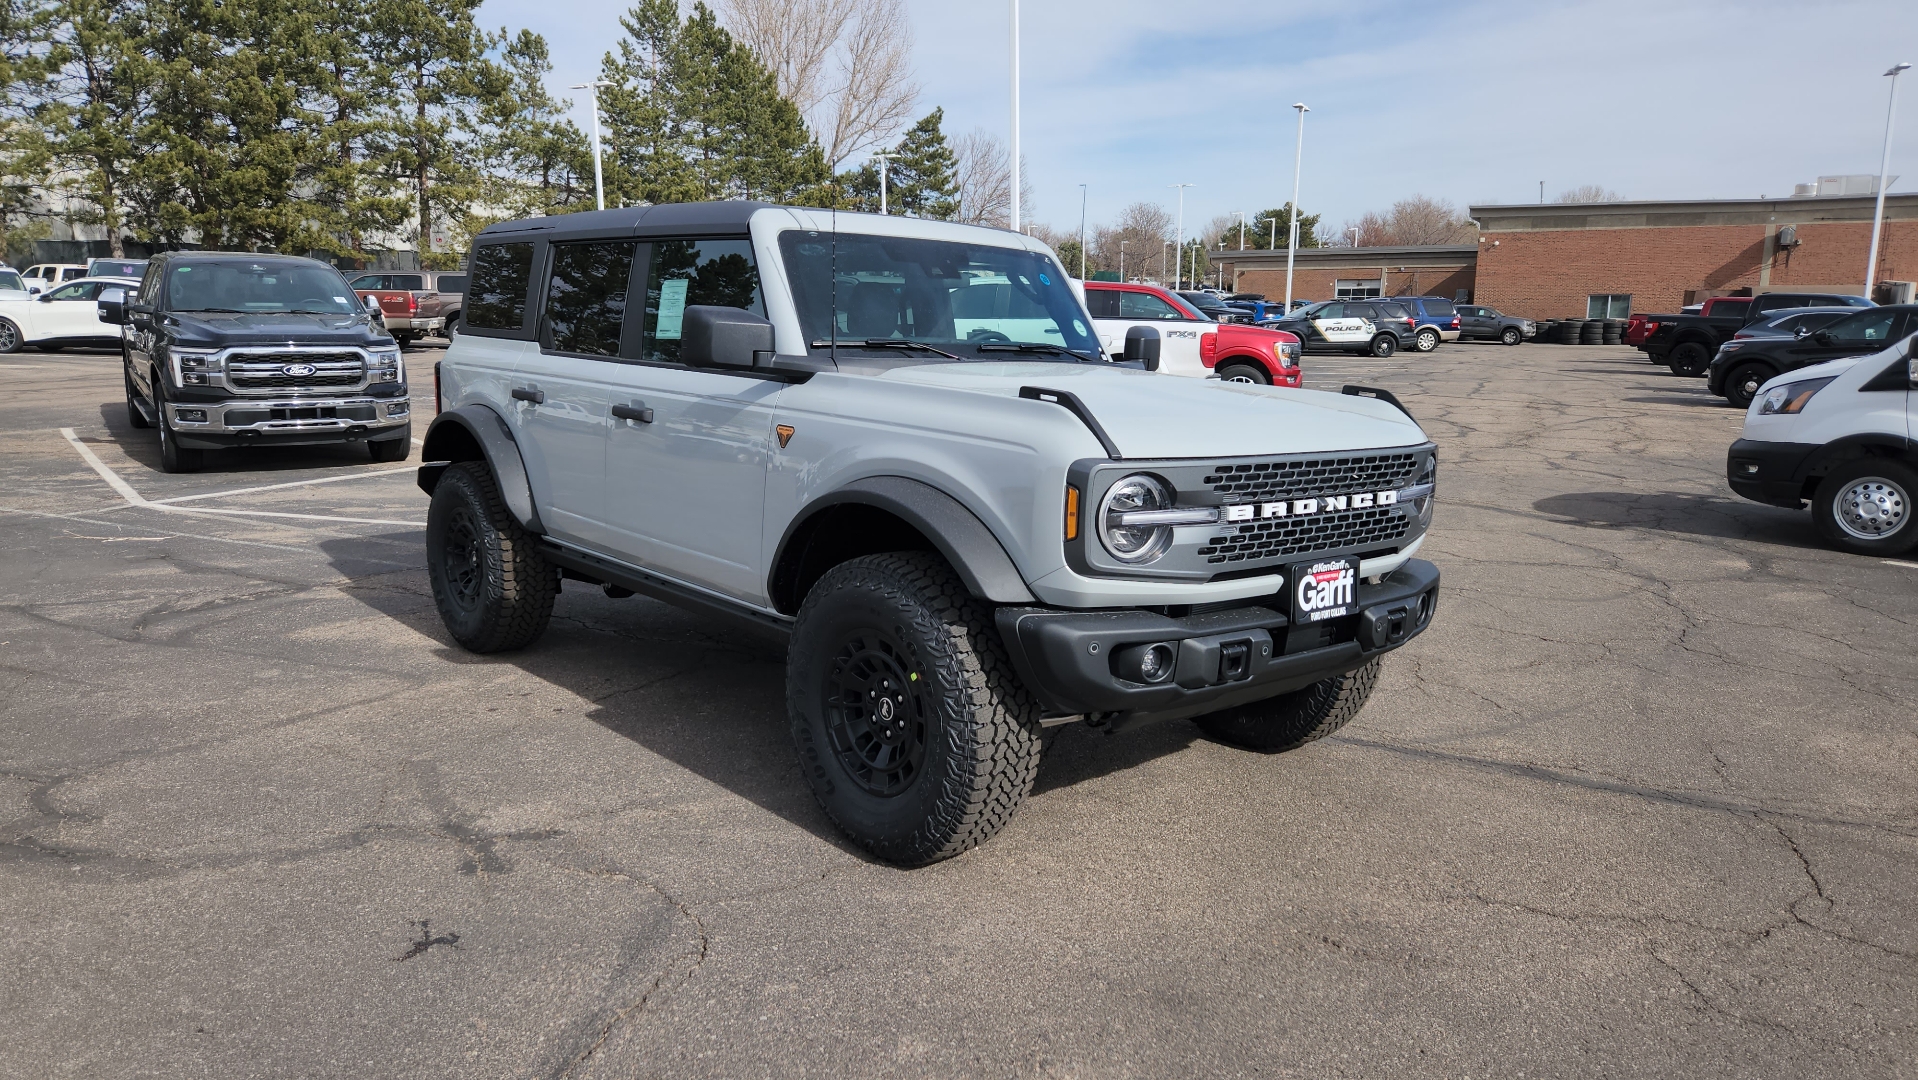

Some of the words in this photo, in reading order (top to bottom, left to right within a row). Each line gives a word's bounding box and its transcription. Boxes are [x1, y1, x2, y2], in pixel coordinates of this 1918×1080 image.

[1167, 330, 1197, 338] FX4
[289, 363, 310, 374] Ford
[1226, 490, 1397, 521] BRONCO
[1298, 569, 1354, 611] Garff
